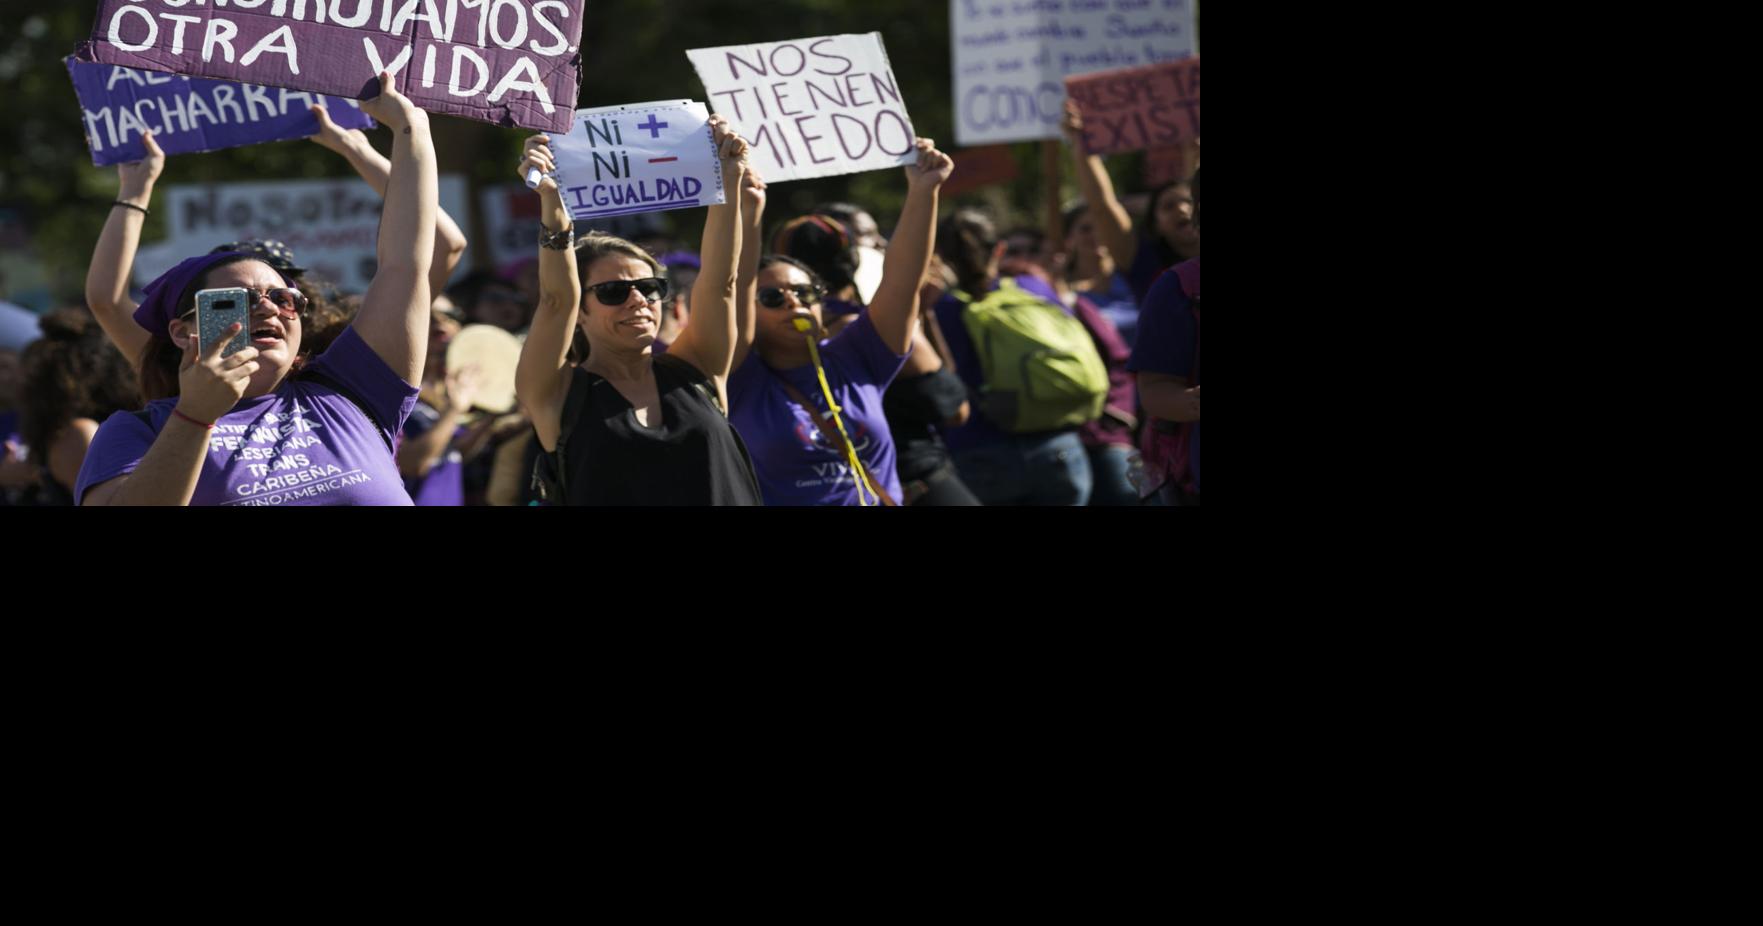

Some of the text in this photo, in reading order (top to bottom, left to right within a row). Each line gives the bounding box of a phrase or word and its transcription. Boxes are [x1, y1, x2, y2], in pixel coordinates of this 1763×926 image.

[107, 5, 555, 113] OTRA VIDA
[726, 39, 852, 80] NOS
[712, 71, 900, 122] TIENEN
[584, 118, 622, 148] Ni
[592, 150, 631, 181] Ni
[567, 176, 702, 210] IGUALDAD
[234, 435, 322, 462] LESBIANA
[236, 463, 342, 497] CARIBEÑA
[247, 453, 311, 479] TRANS
[229, 472, 372, 506] TINOAMERICANA
